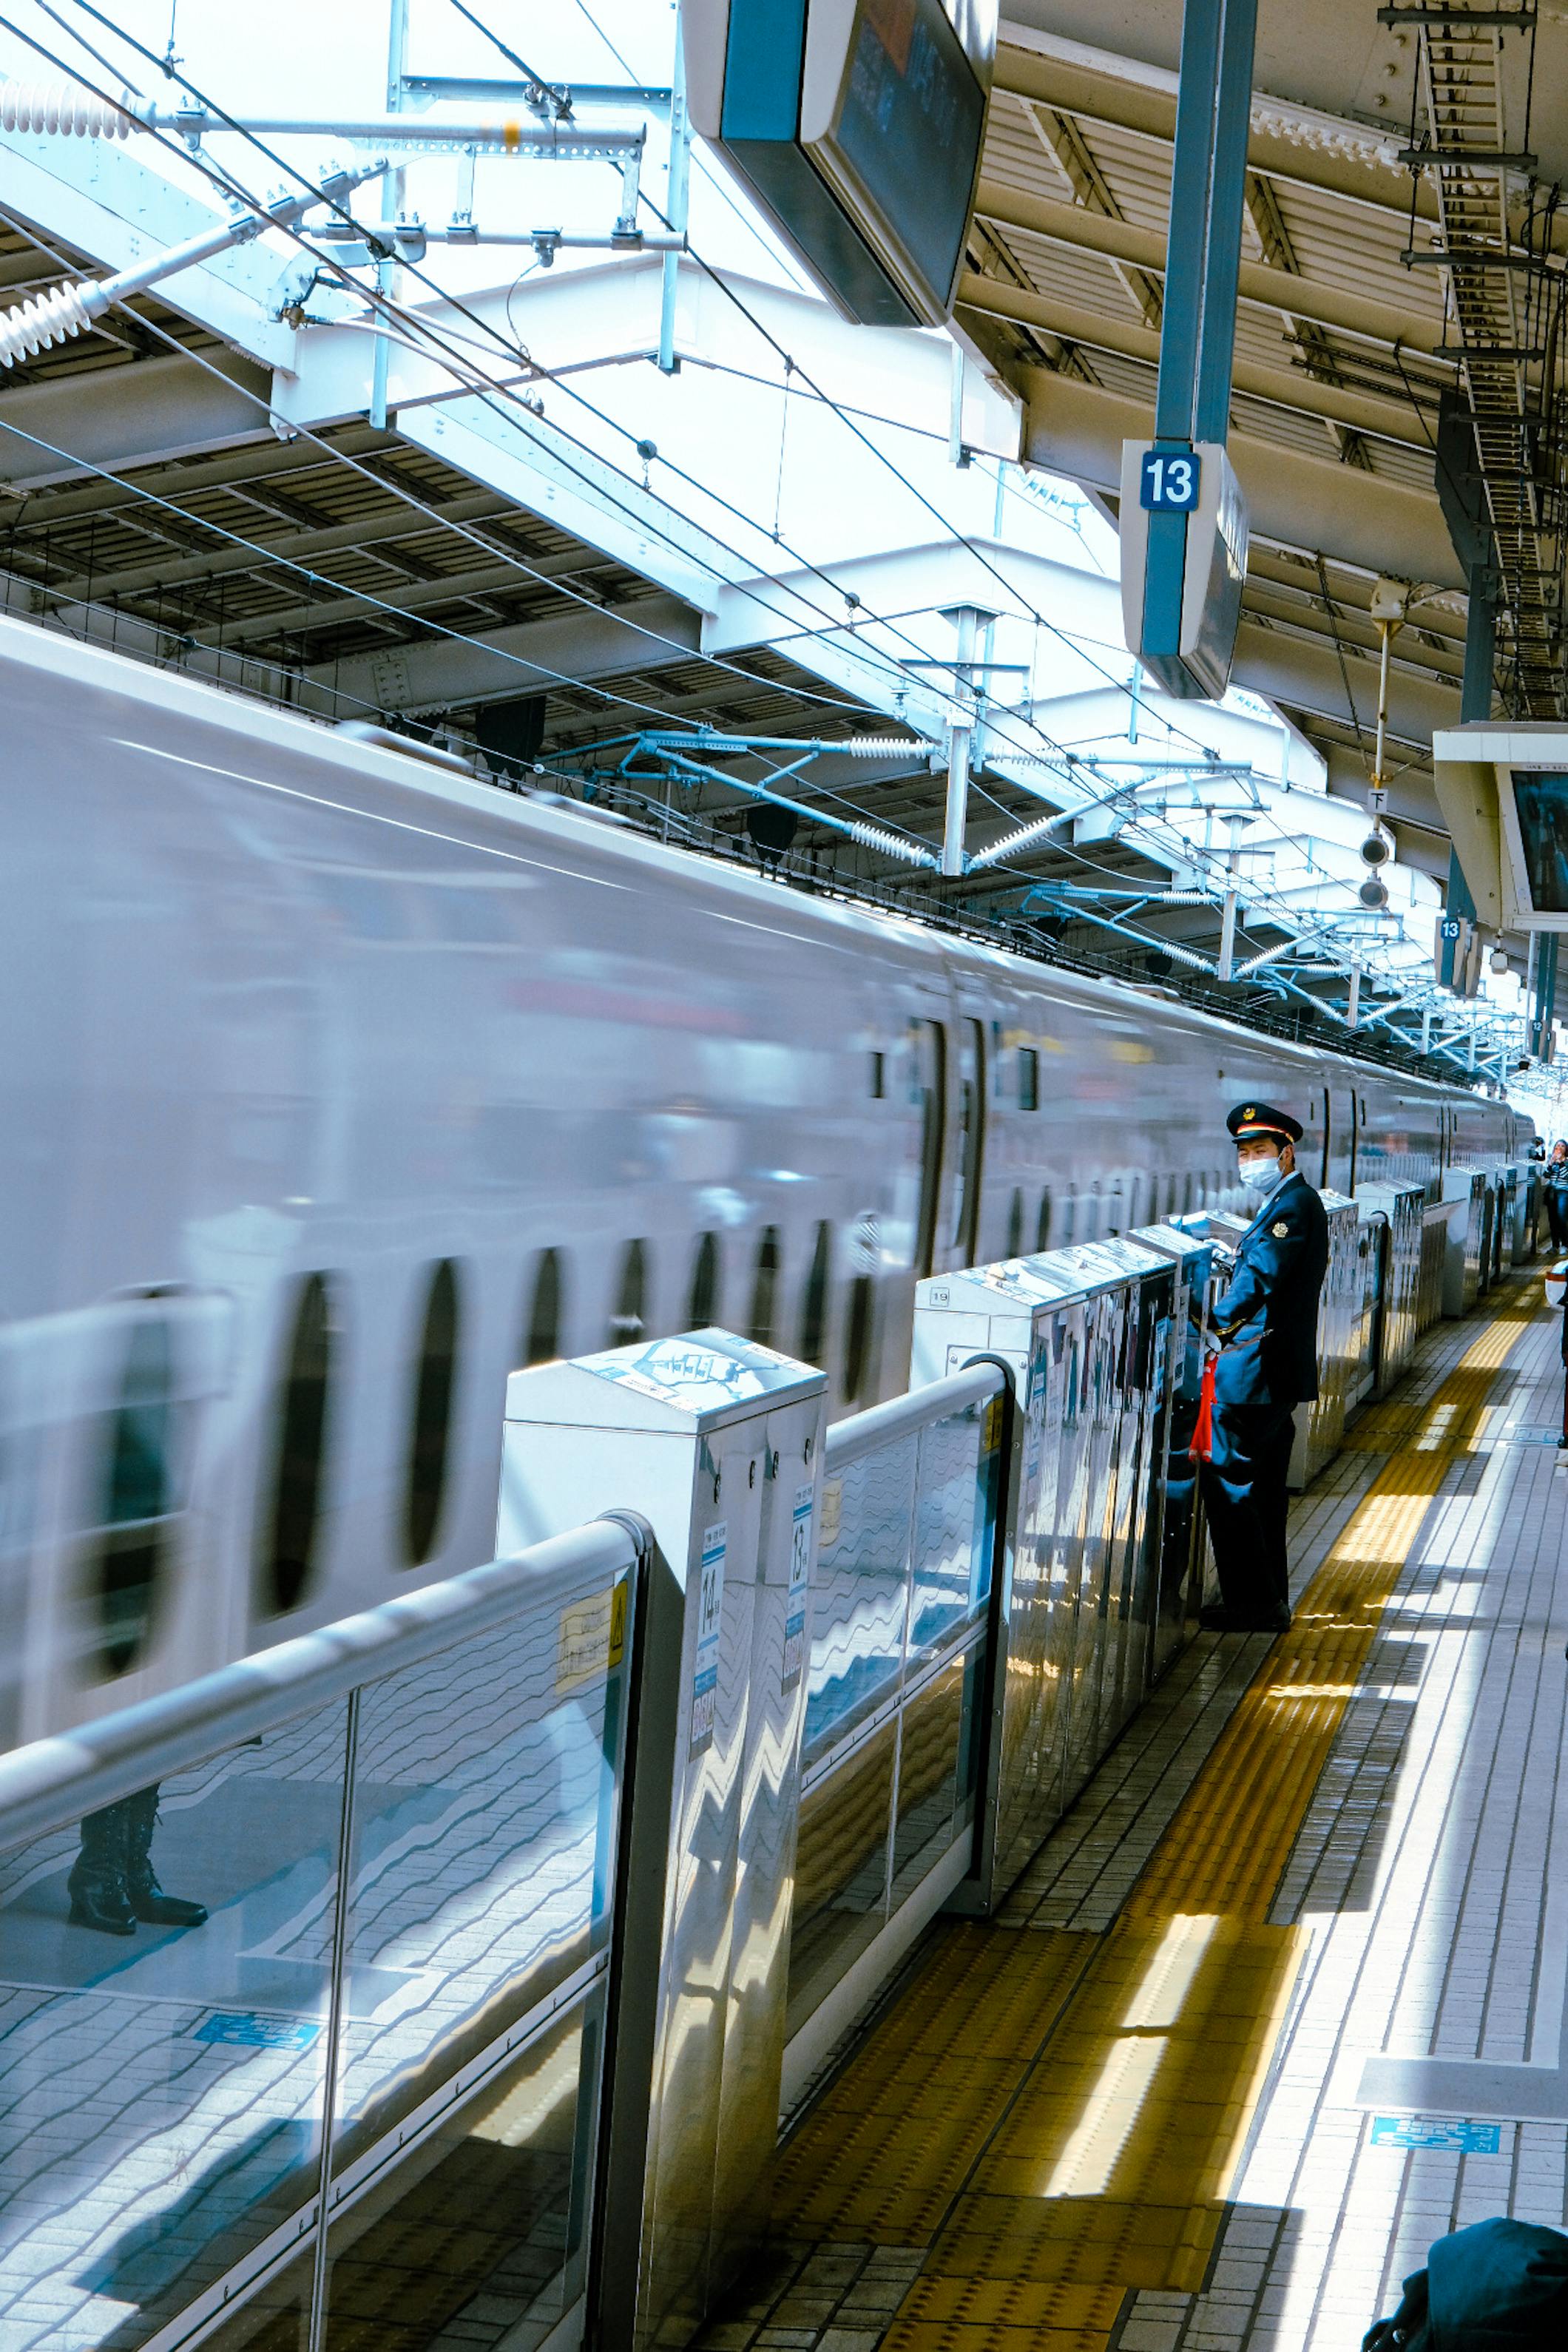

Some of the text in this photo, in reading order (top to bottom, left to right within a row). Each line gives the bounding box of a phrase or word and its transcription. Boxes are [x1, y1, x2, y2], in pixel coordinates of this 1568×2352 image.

[1146, 459, 1192, 503] 13
[1371, 793, 1385, 810] 下
[1443, 922, 1459, 937] 13
[1533, 1021, 1542, 1031] 12
[934, 1293, 947, 1301] 19
